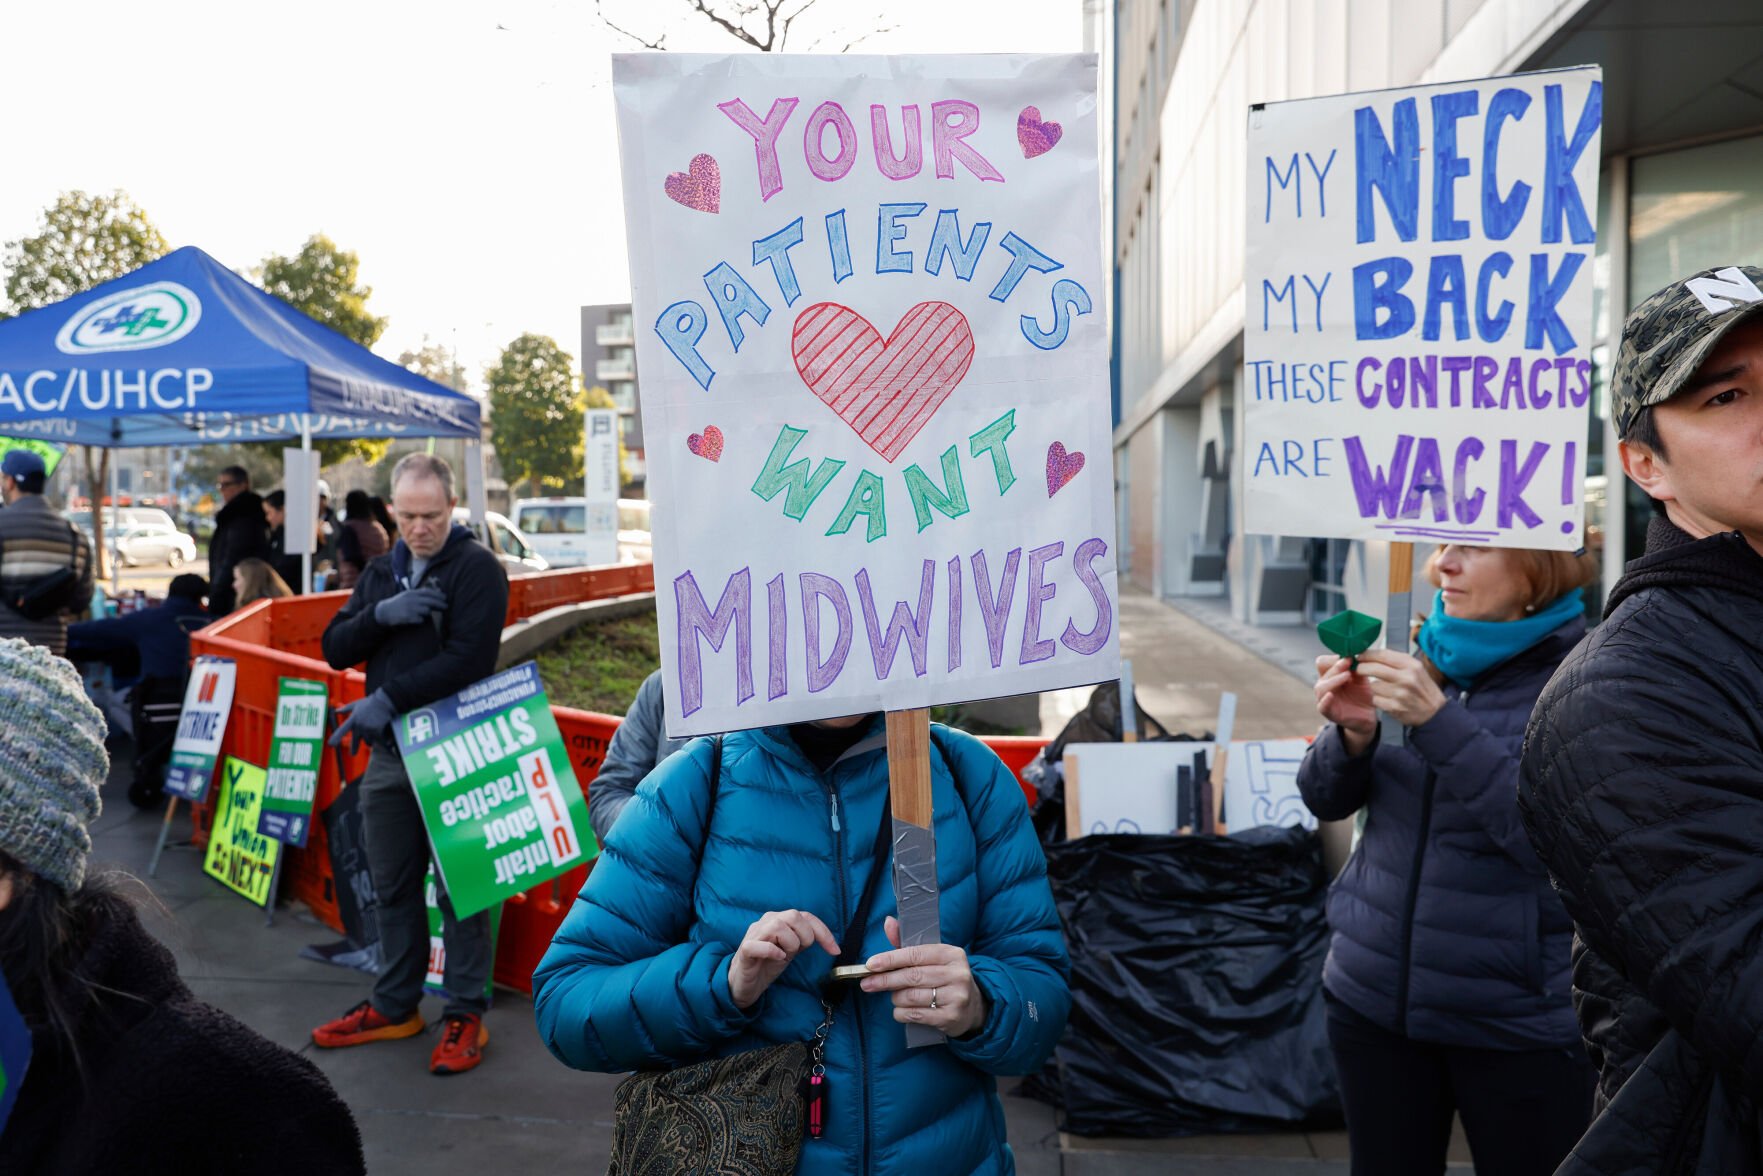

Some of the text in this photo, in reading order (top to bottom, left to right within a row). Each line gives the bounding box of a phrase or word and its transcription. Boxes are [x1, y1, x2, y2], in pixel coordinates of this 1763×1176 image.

[717, 96, 1005, 203] YOUR
[1264, 80, 1603, 245] MY NECK
[654, 203, 1092, 392] PATIENTS
[1263, 251, 1586, 356] MY BACK
[1246, 354, 1593, 410] THESE CONTRACTS
[751, 408, 1017, 543] WANT
[1253, 434, 1577, 534] ARE WACK!
[673, 537, 1112, 719] MIDWIVES
[264, 767, 317, 802] PATIENTS
[425, 706, 538, 788] STRIKE
[572, 735, 600, 752] CITY
[227, 849, 273, 898] NEXT
